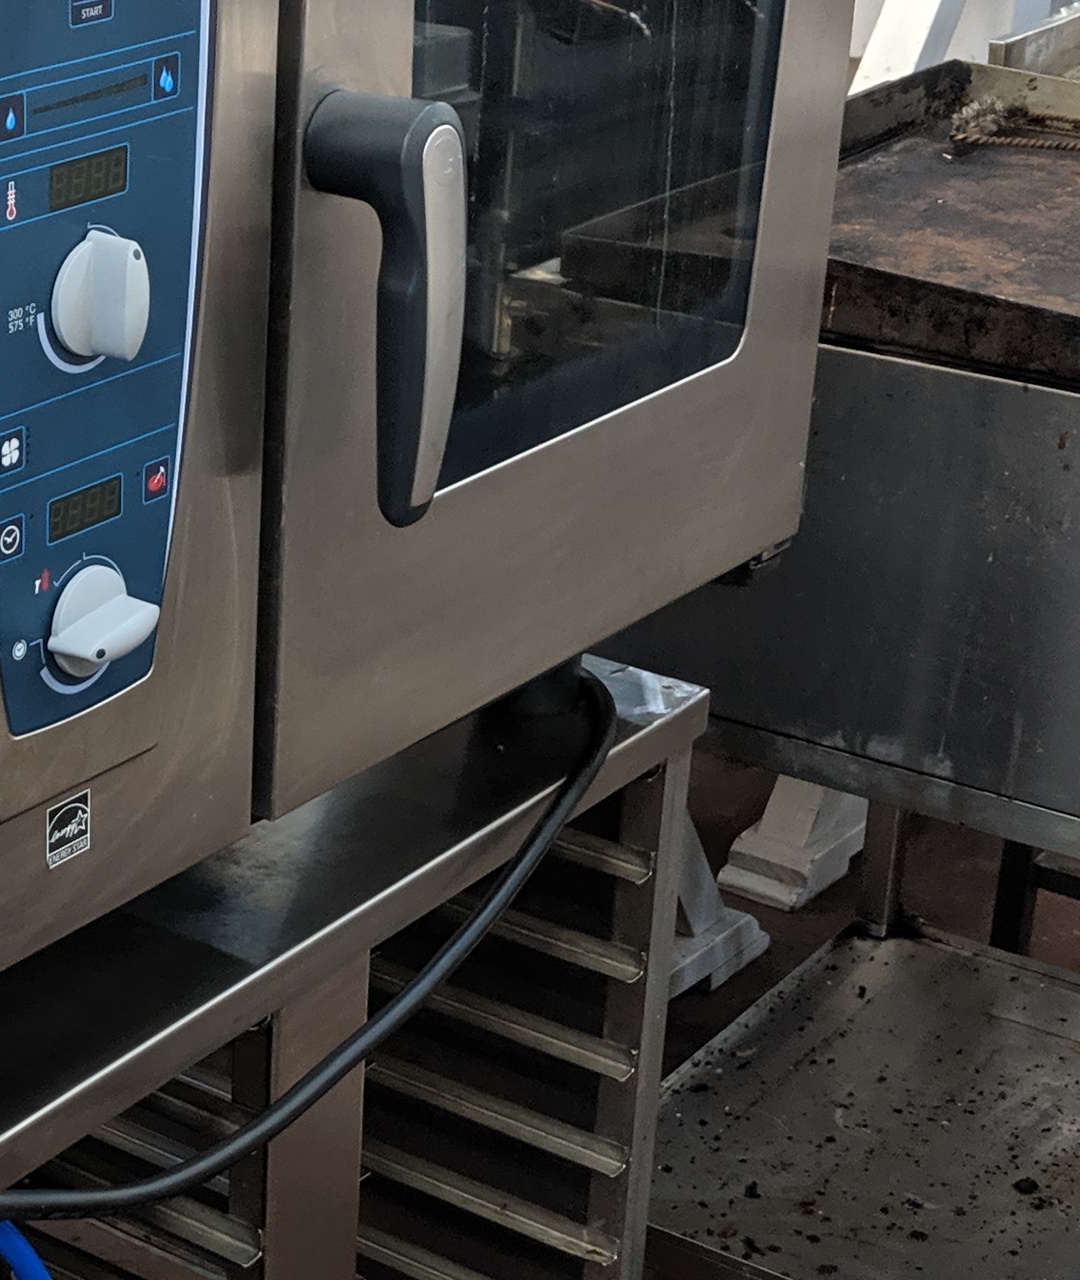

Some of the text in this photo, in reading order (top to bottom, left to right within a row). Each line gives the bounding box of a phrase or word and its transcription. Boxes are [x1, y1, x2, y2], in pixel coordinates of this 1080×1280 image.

[81, 4, 103, 20] START
[7, 306, 24, 322] 300
[8, 318, 24, 334] 575
